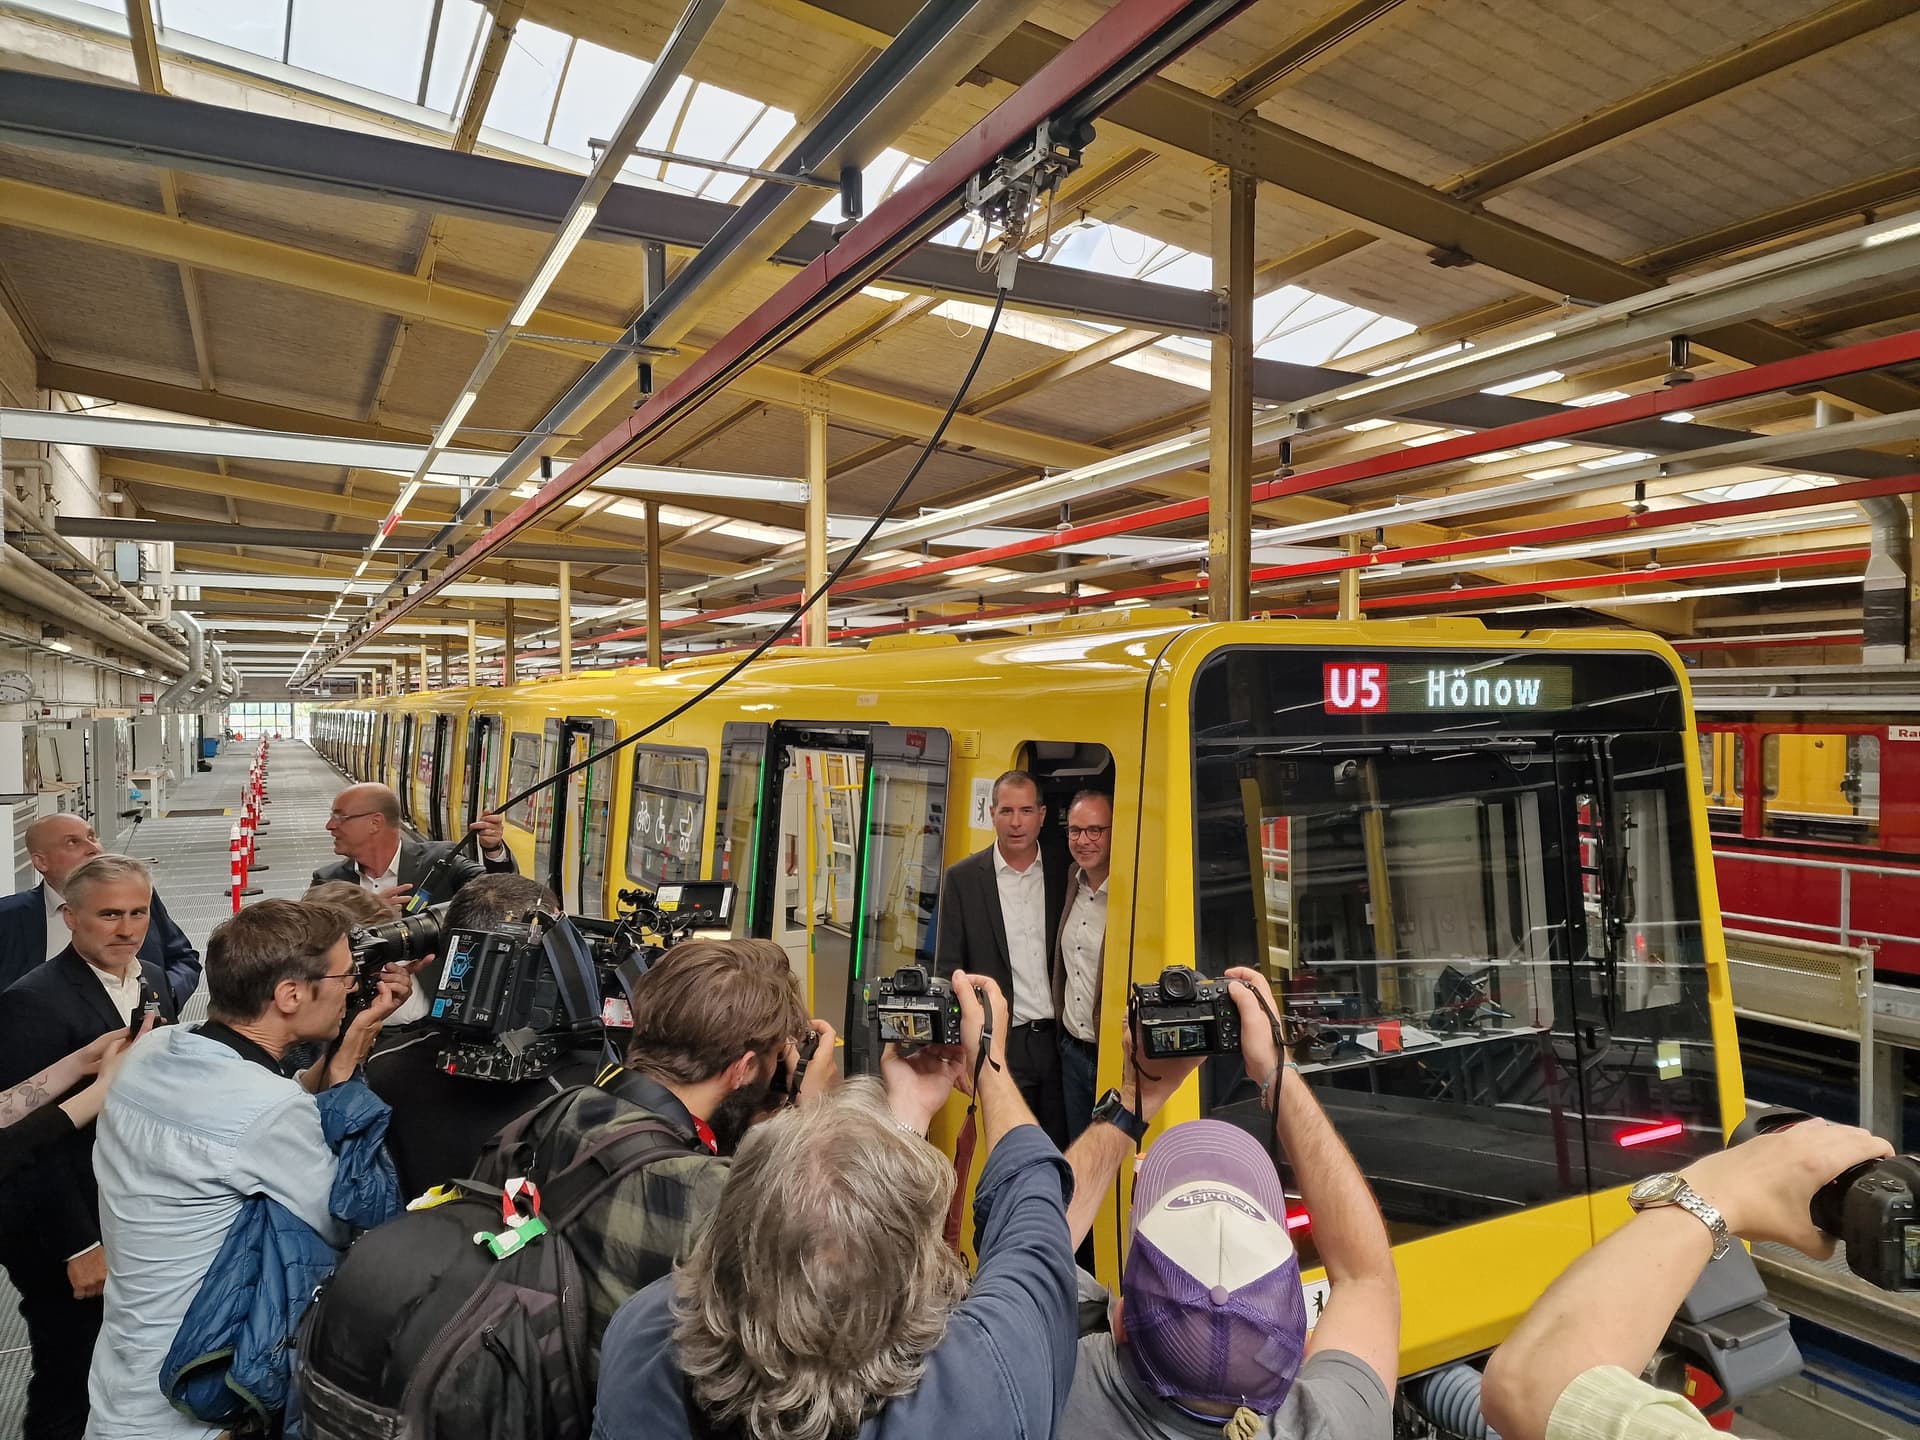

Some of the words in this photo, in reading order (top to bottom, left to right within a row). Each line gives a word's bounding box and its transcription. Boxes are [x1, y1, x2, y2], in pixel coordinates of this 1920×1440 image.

[1330, 667, 1381, 708] U5
[1428, 668, 1541, 707] Hönow
[1898, 728, 1920, 738] Ra
